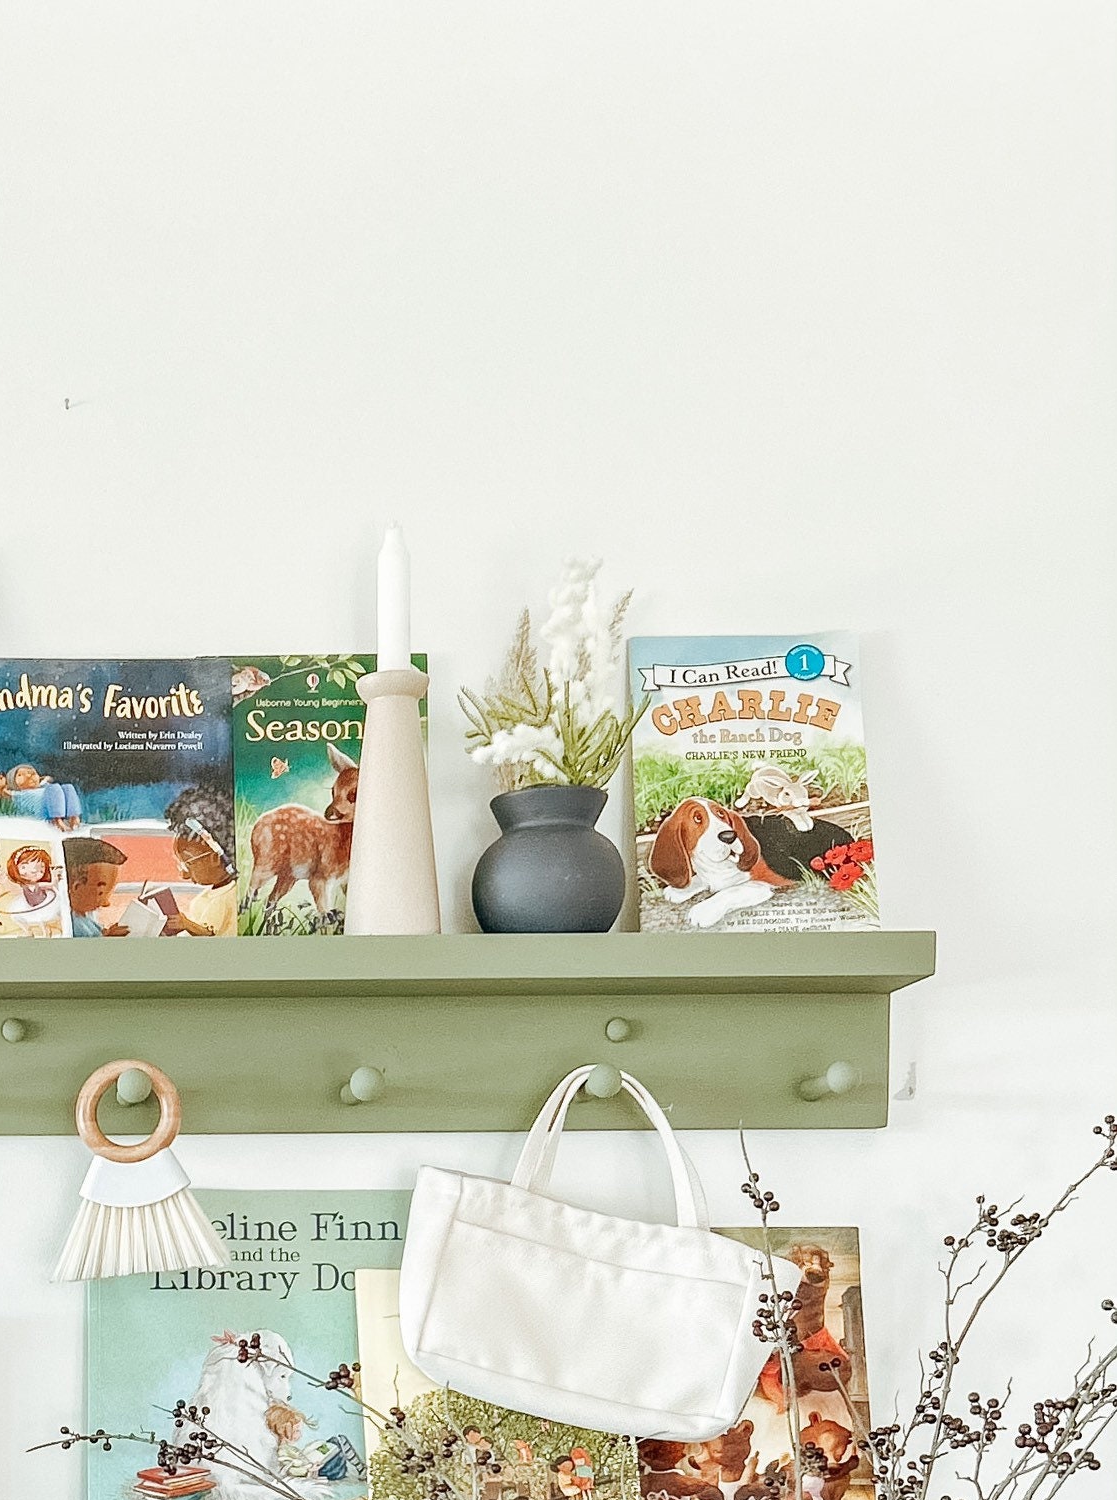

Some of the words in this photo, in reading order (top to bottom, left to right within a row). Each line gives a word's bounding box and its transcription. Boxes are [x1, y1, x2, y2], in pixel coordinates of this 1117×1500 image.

[799, 653, 809, 671] 1
[669, 669, 677, 684] I
[682, 669, 720, 685] Can
[725, 661, 778, 680] Read!
[103, 682, 204, 719] Favorite
[255, 699, 291, 708] Usborne
[293, 699, 319, 709] Young
[651, 689, 842, 736] CHARLIE
[118, 730, 147, 740] Written
[148, 731, 158, 741] by
[245, 710, 363, 742] Season
[691, 729, 717, 743] the
[719, 728, 766, 743] Ranch
[769, 727, 803, 746] Dog
[63, 741, 102, 752] Illustrated
[103, 742, 114, 751] by
[685, 750, 739, 761] CHARLIE'S
[742, 750, 766, 759] NEW
[770, 748, 807, 759] FRIEND
[211, 1212, 297, 1241] eline
[310, 1211, 403, 1241] Finn
[230, 1247, 263, 1262] and
[270, 1247, 301, 1262] the
[150, 1267, 300, 1299] Library
[312, 1263, 355, 1291] Do
